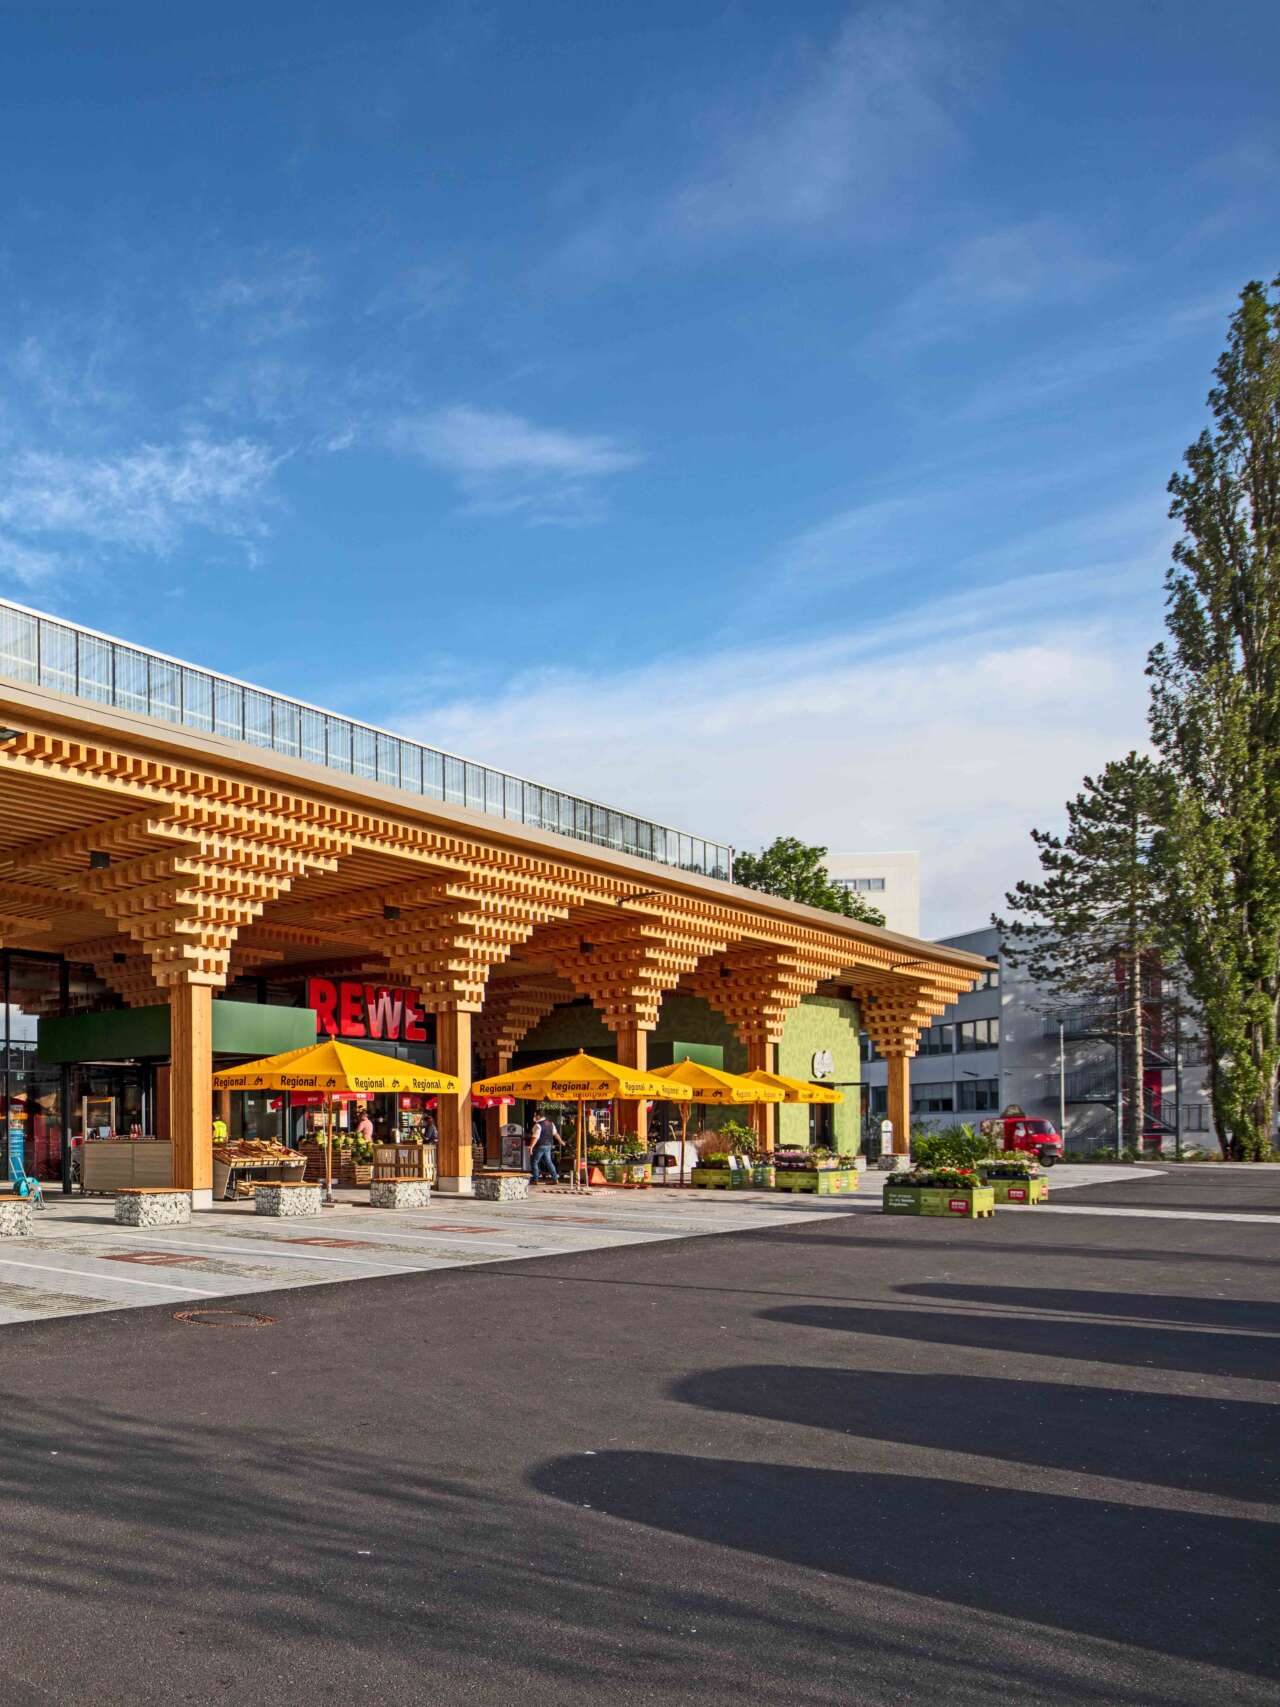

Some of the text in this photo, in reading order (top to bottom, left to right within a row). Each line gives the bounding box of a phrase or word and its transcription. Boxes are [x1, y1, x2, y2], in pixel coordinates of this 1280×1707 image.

[308, 976, 427, 1041] REWE
[213, 1076, 247, 1088] Regional
[280, 1075, 318, 1088] Regional
[354, 1077, 385, 1090] Regional
[412, 1078, 442, 1091] Regional
[551, 1081, 590, 1092] Regional
[479, 1083, 514, 1094] Regional
